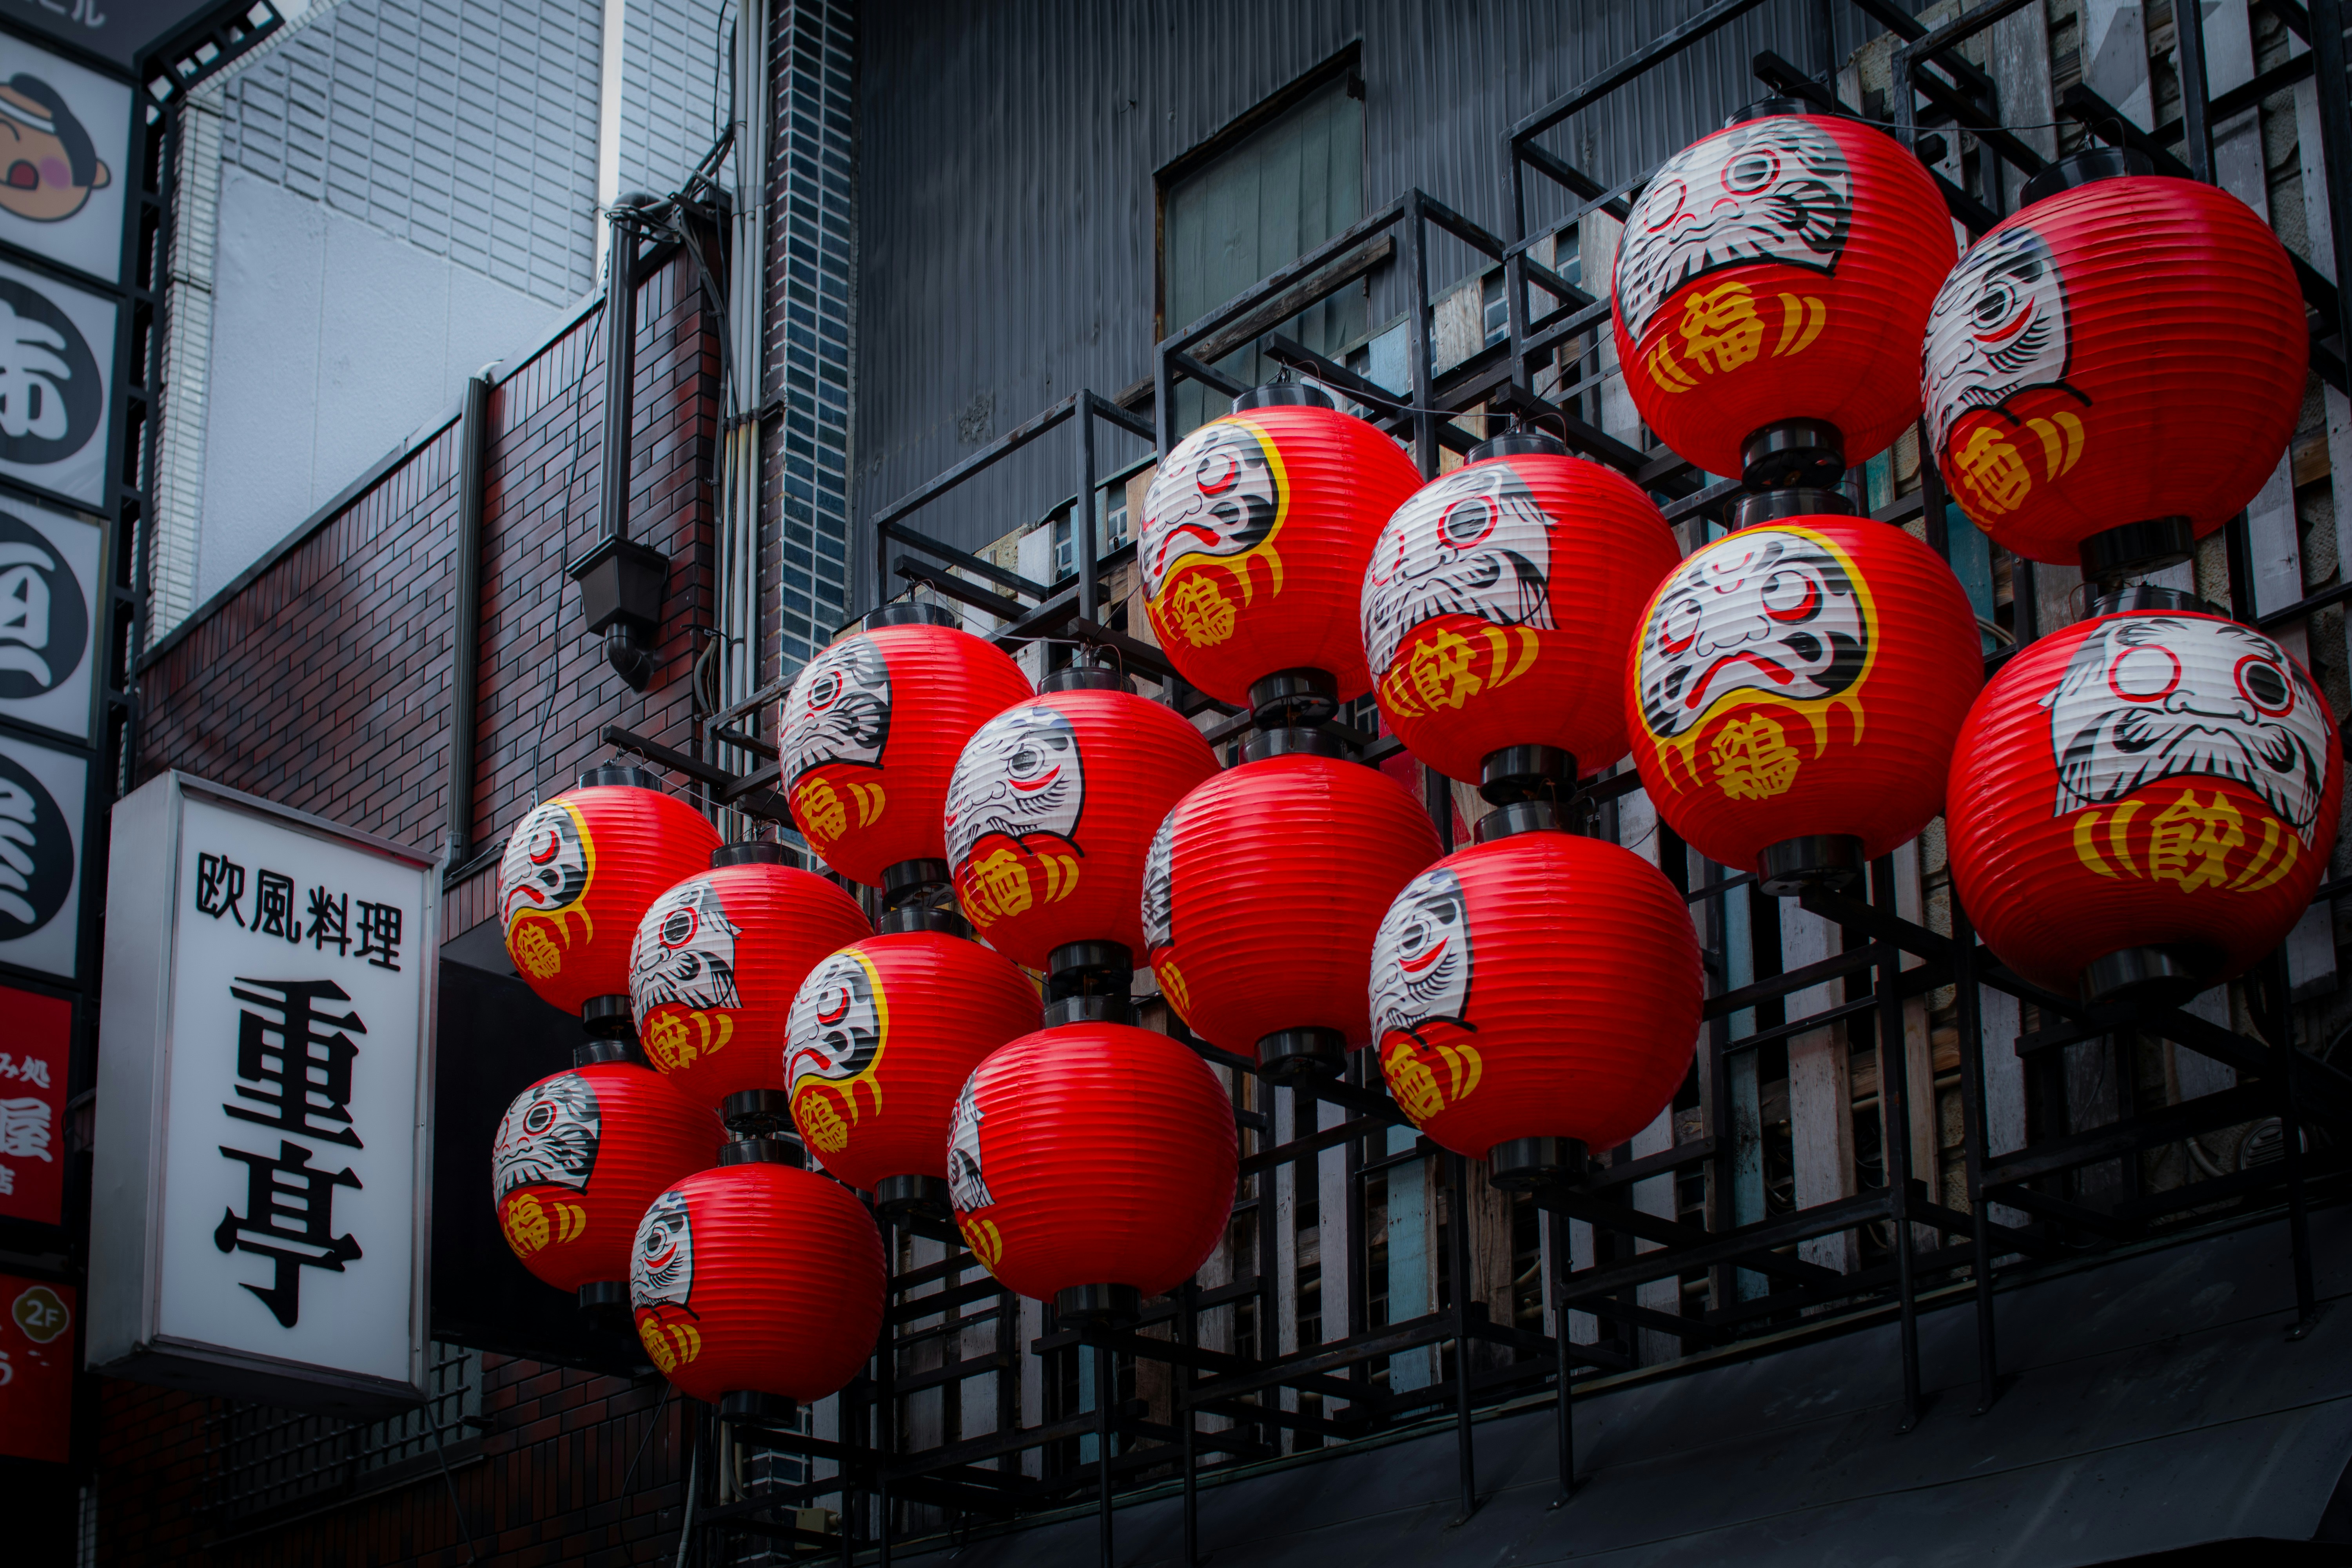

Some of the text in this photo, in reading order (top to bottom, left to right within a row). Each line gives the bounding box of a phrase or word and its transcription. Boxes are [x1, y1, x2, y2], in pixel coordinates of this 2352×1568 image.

[1679, 281, 1765, 372] 福
[1955, 426, 2032, 514] 酒
[1409, 628, 1483, 712] 餃
[799, 777, 847, 842] 福
[2149, 789, 2245, 893] 餃
[197, 852, 402, 971] 欧風料理
[973, 849, 1033, 916] 酒
[651, 1011, 697, 1069] 餃
[214, 976, 367, 1328] 重亭
[507, 1194, 549, 1251] 福
[25, 1299, 59, 1328] 2F
